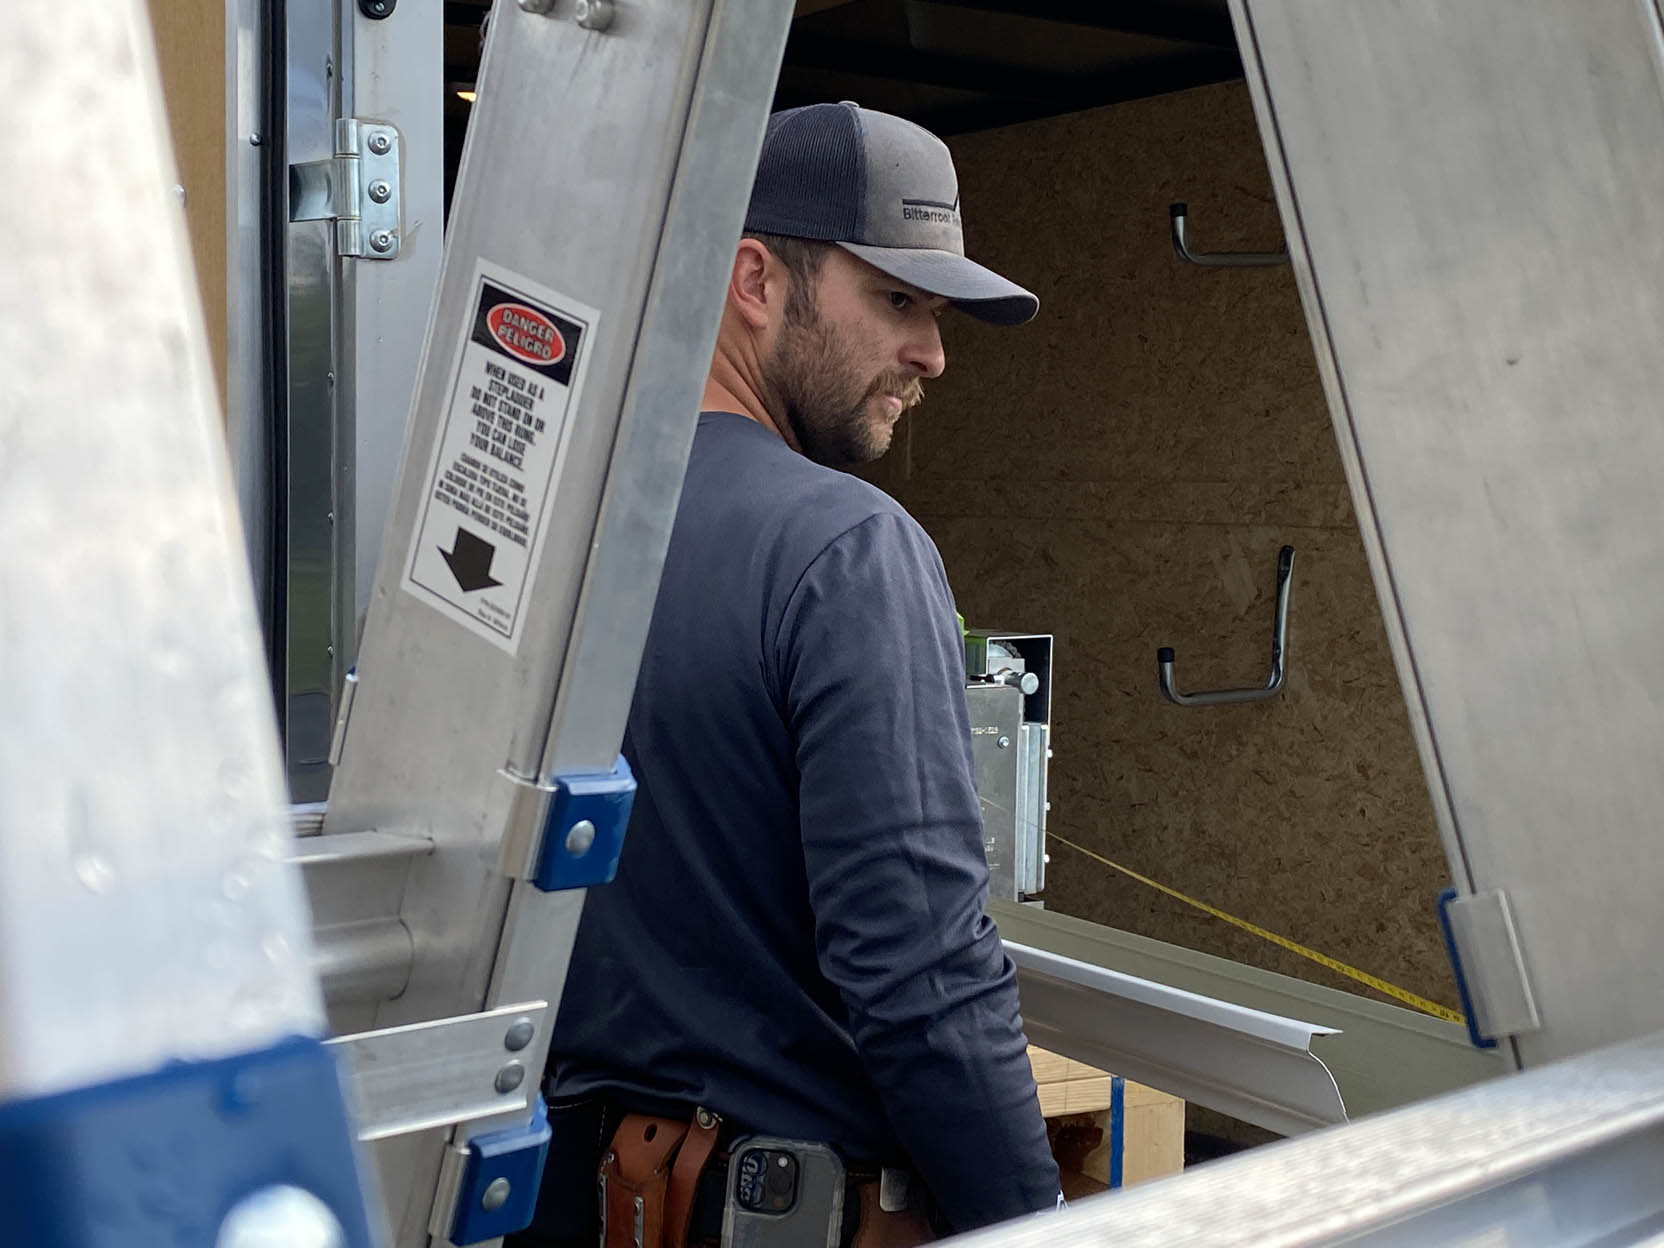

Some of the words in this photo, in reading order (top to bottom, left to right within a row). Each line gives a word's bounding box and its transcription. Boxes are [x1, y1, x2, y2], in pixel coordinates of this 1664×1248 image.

[502, 308, 554, 344] DANGER
[498, 324, 552, 360] PELIGRO
[486, 362, 507, 381] WHEN
[472, 387, 482, 401] DO
[484, 393, 498, 409] NOT
[499, 401, 522, 421] STAND
[524, 412, 533, 427] ON
[473, 403, 496, 424] ABOVE
[497, 415, 514, 433] THIS
[470, 434, 489, 452] YOUR
[477, 421, 491, 437] YOU
[493, 429, 507, 445] CAN
